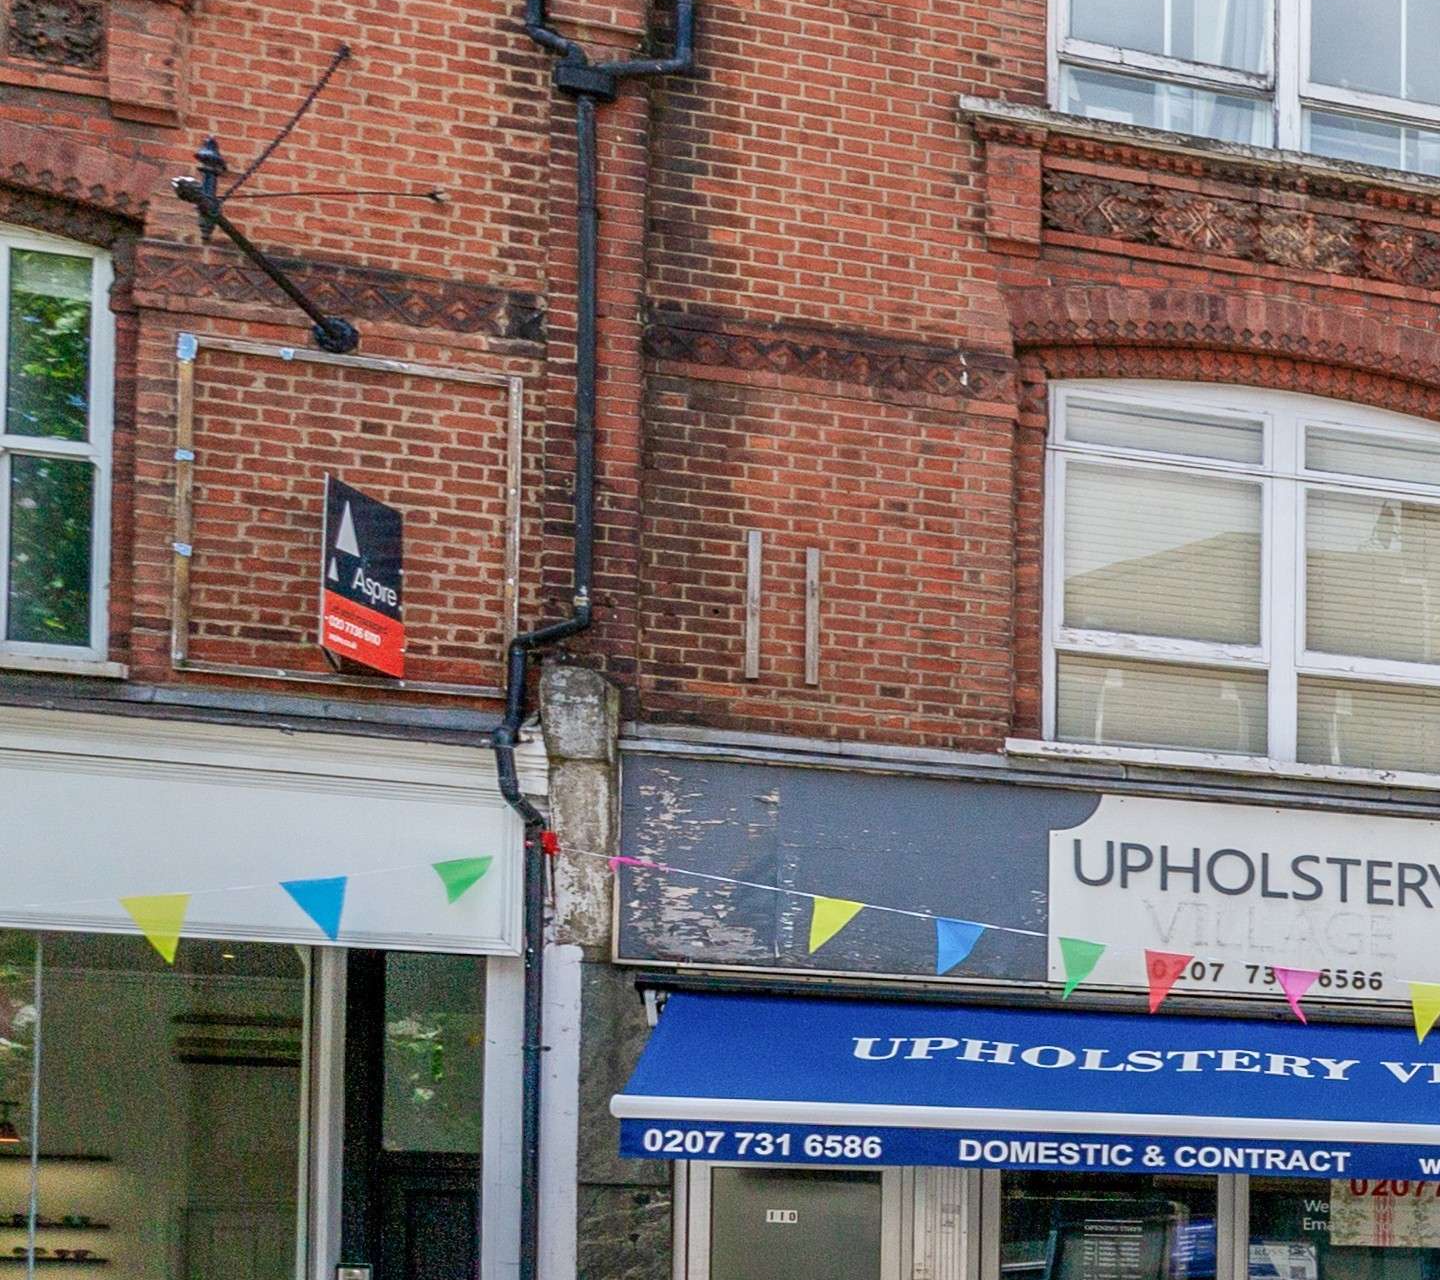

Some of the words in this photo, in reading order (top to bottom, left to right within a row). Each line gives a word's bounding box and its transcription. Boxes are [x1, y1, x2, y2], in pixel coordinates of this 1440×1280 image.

[352, 568, 398, 606] Aspire
[1244, 964, 1286, 986] 73
[1317, 968, 1383, 991] 6586
[851, 1036, 1360, 1082] UPHOLSTERY
[643, 1128, 725, 1154] 0207
[735, 1131, 791, 1156] 731
[804, 1134, 882, 1158] 6586
[958, 1139, 1134, 1167] DOMESTIC
[1143, 1144, 1166, 1167] &
[1174, 1145, 1351, 1174] CONTRACT
[768, 1210, 797, 1222] 110
